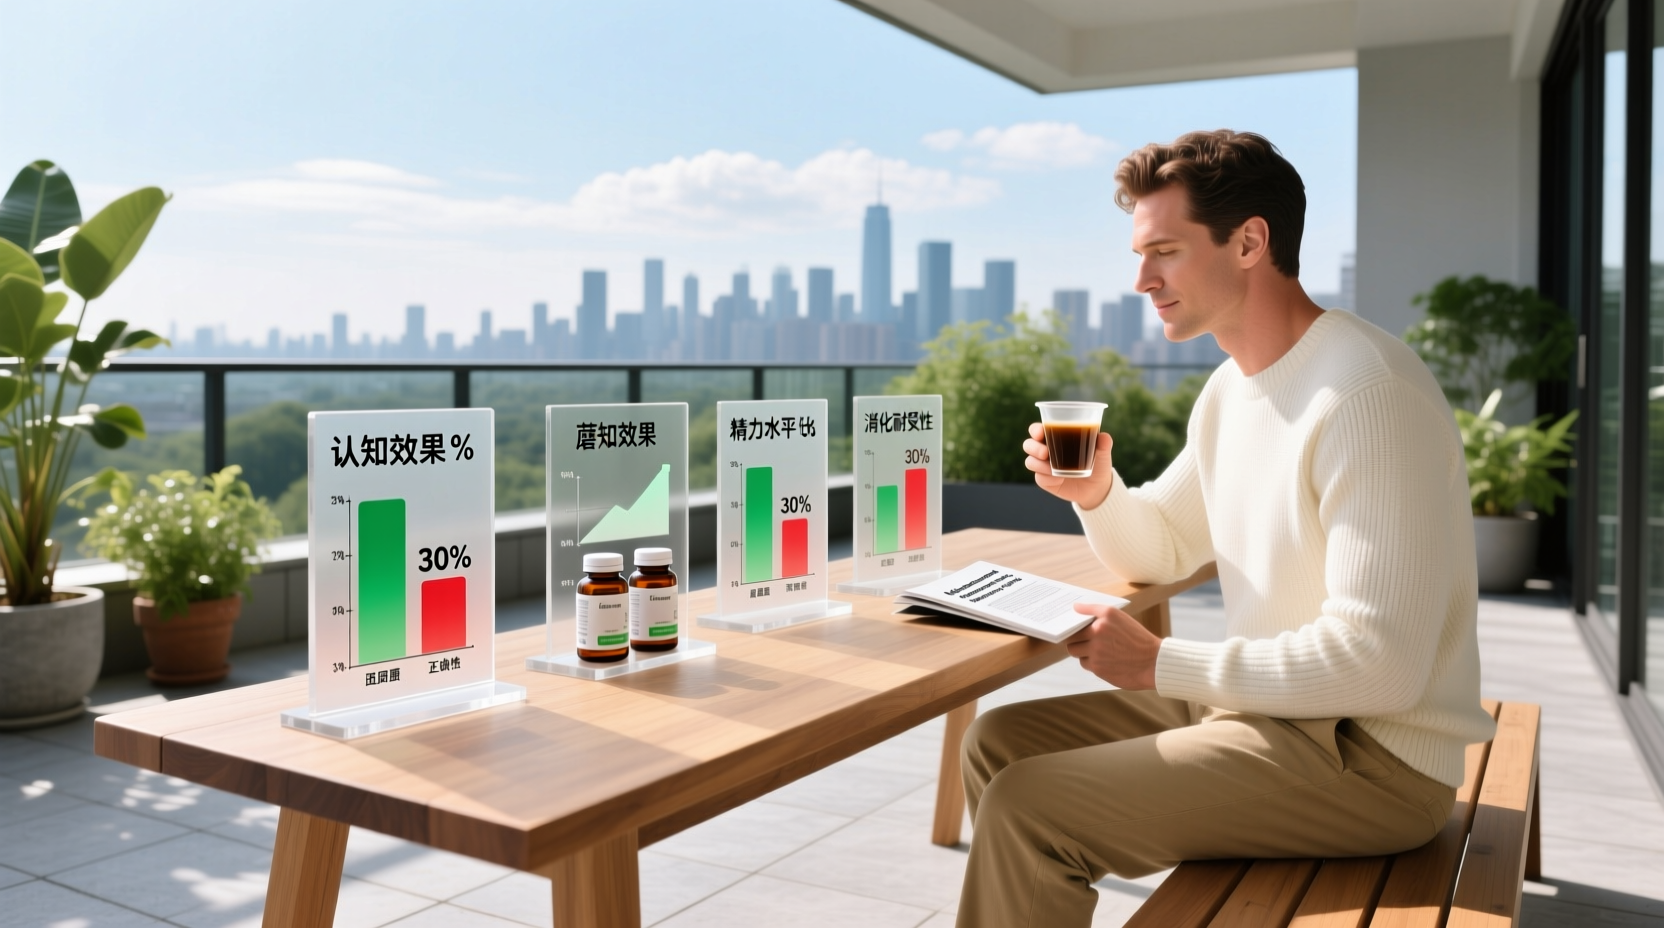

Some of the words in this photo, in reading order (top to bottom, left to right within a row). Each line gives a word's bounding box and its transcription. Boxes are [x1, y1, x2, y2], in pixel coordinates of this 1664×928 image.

[905, 448, 930, 464] 30%
[780, 494, 812, 514] 30%
[418, 544, 472, 572] 30%
